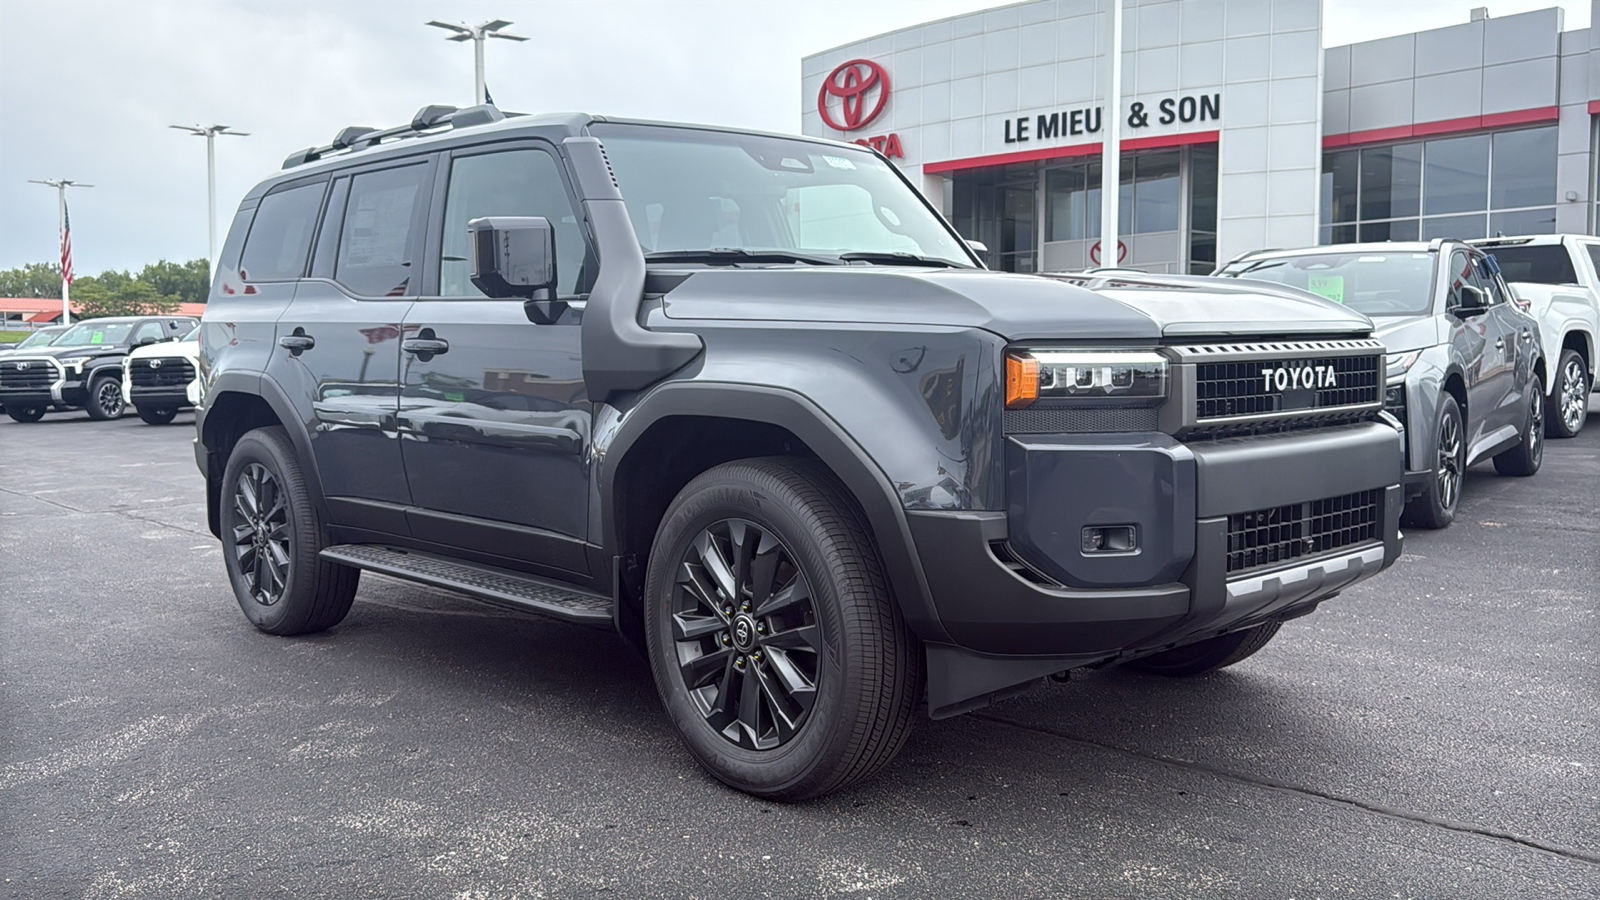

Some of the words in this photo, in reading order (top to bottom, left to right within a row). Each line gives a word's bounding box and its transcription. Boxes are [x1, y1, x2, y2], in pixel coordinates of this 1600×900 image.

[1004, 117, 1029, 143] LE
[1037, 106, 1104, 140] MIEU
[1127, 102, 1149, 128] &
[1159, 93, 1220, 125] SON
[1261, 365, 1337, 392] TOYOTA
